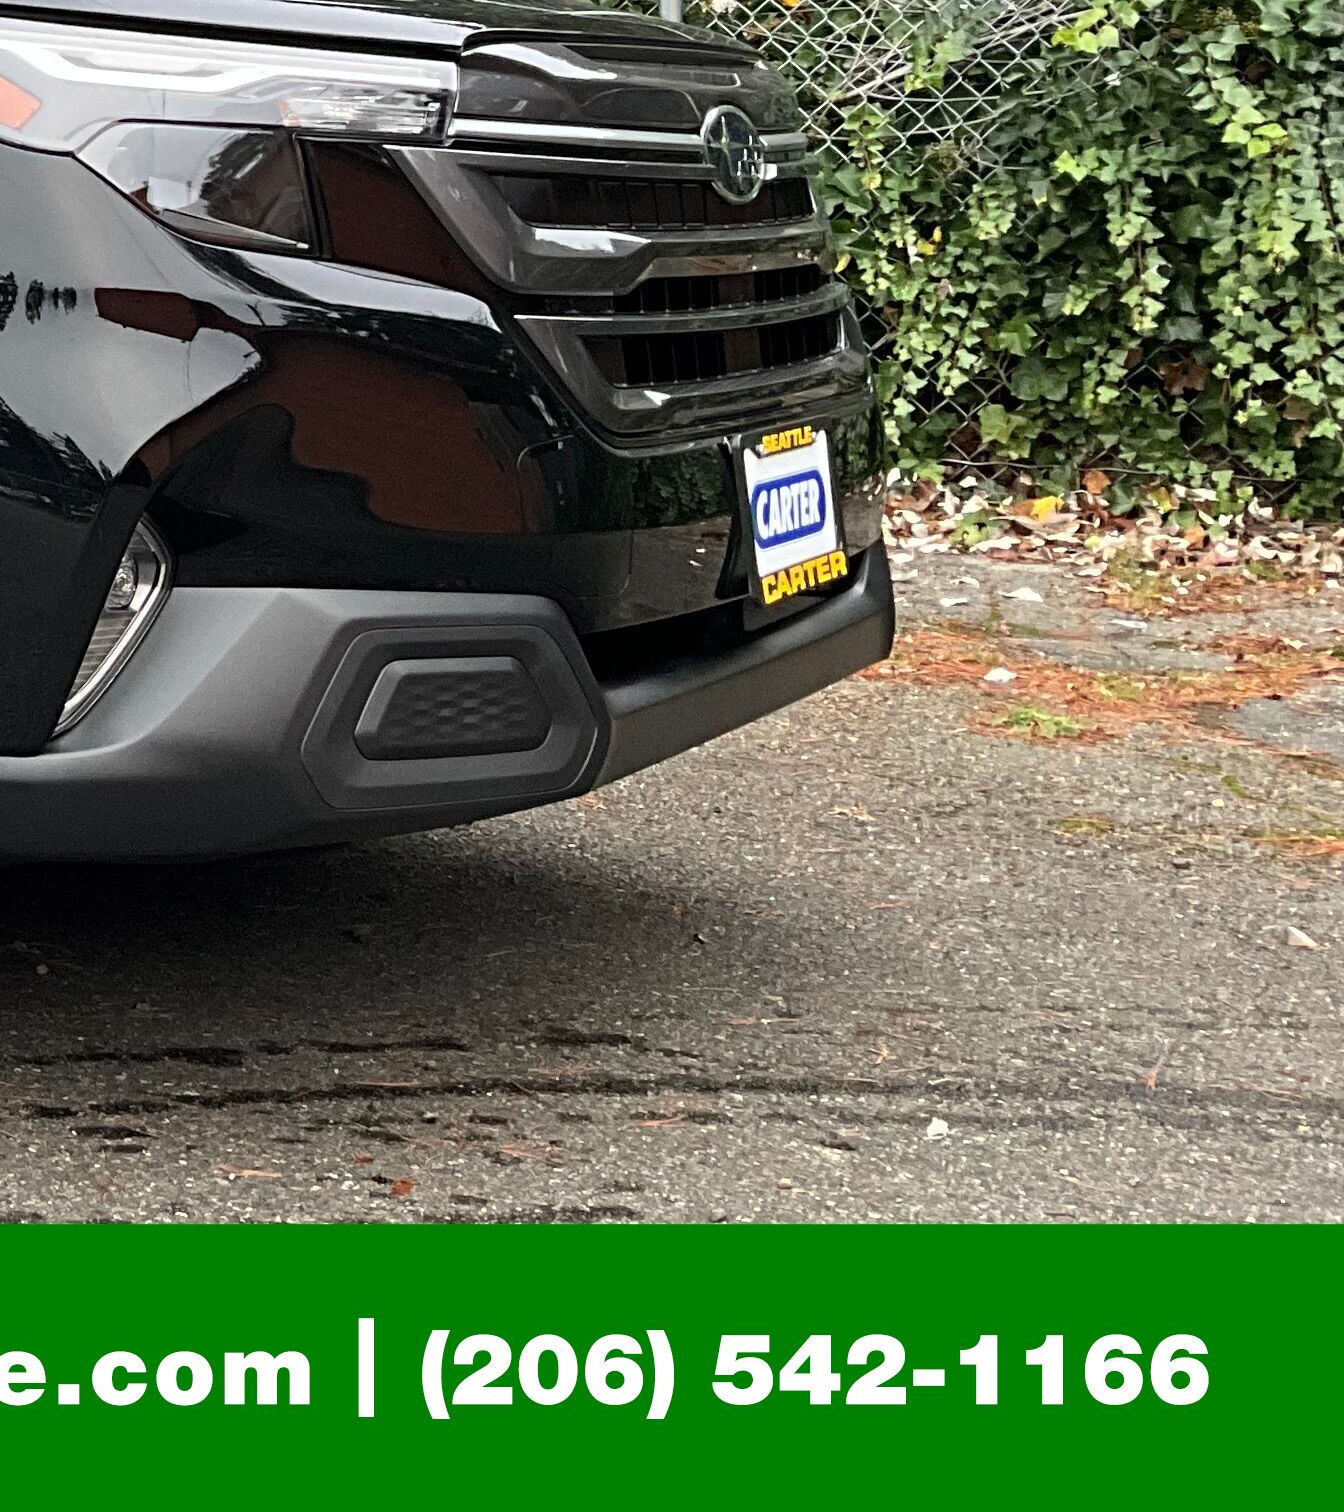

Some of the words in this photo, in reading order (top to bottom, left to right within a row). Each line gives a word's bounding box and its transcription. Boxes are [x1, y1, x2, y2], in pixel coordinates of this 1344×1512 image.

[762, 425, 813, 454] SEATTLE
[756, 477, 821, 540] CARTER
[762, 550, 848, 605] CARTER
